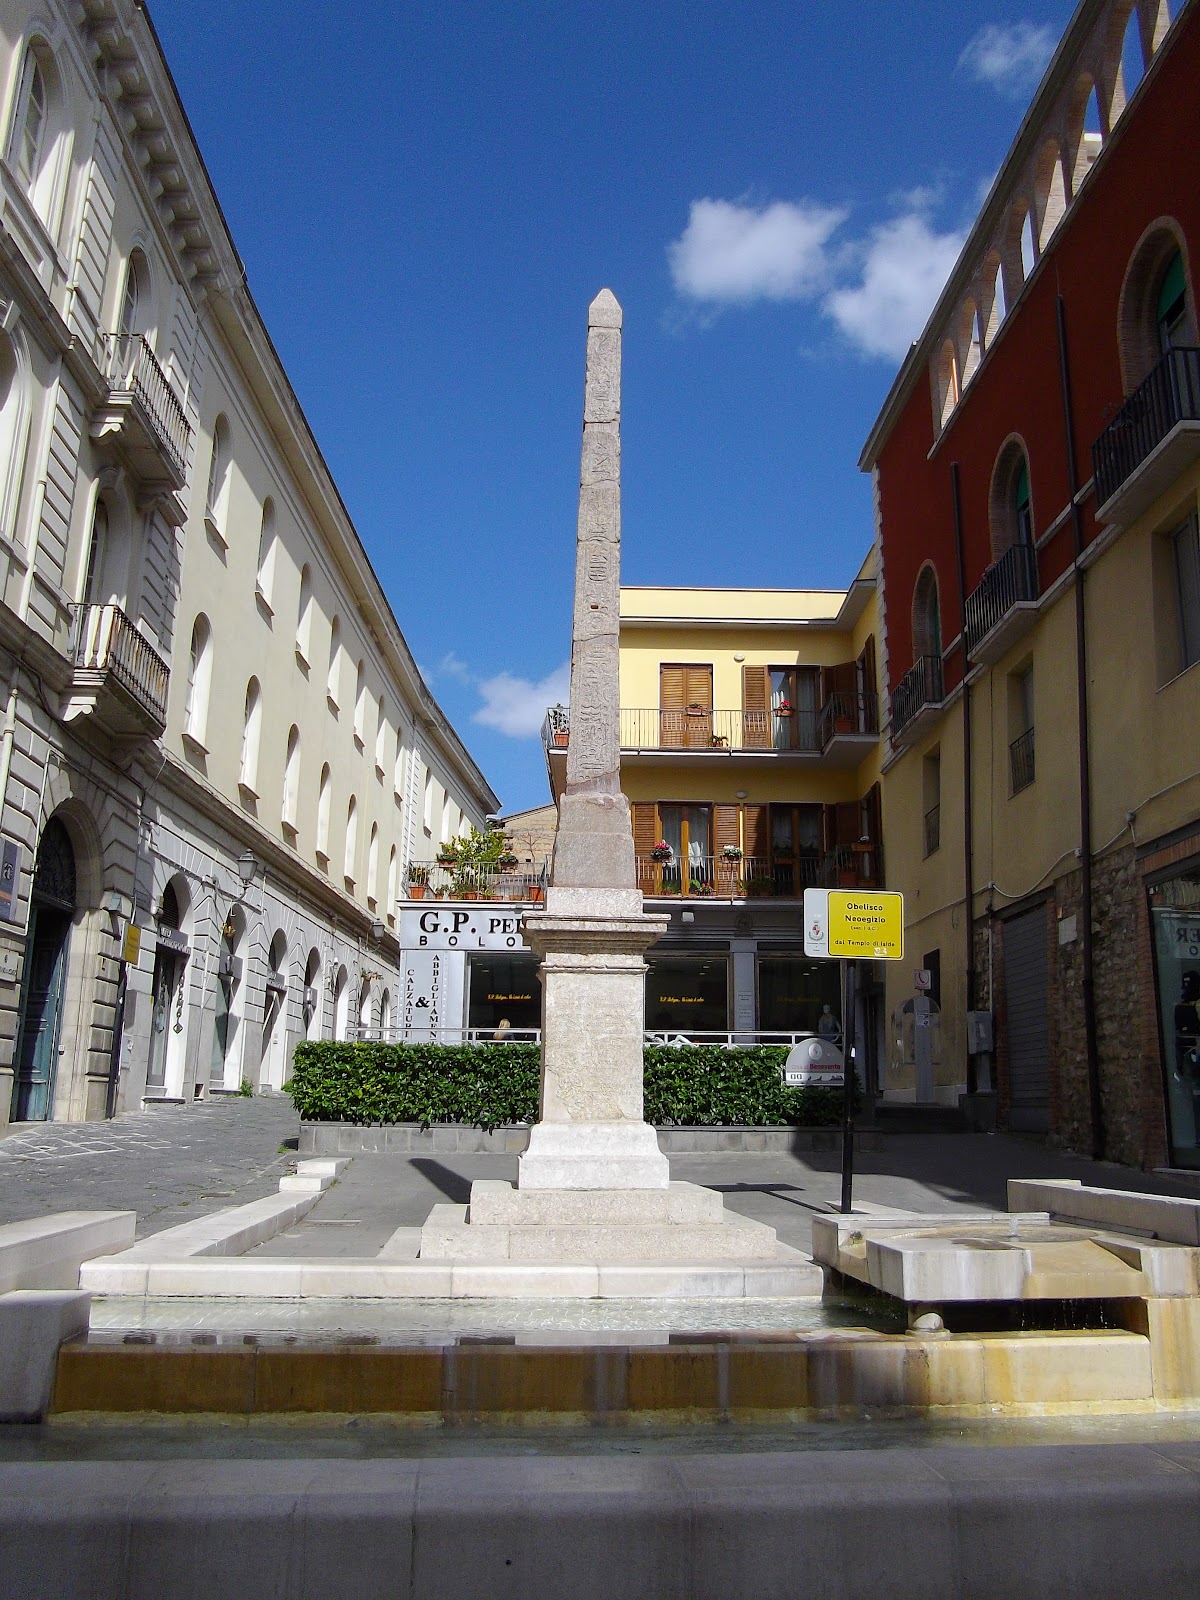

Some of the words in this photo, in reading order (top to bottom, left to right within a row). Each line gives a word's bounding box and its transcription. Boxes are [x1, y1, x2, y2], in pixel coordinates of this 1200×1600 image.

[846, 902, 883, 911] Obelisco
[419, 911, 477, 934] G.P.
[845, 914, 886, 923] Neoegizio
[419, 935, 516, 947] BOLO
[415, 996, 430, 1008] &
[429, 954, 440, 1040] ABBIGLIAMEN
